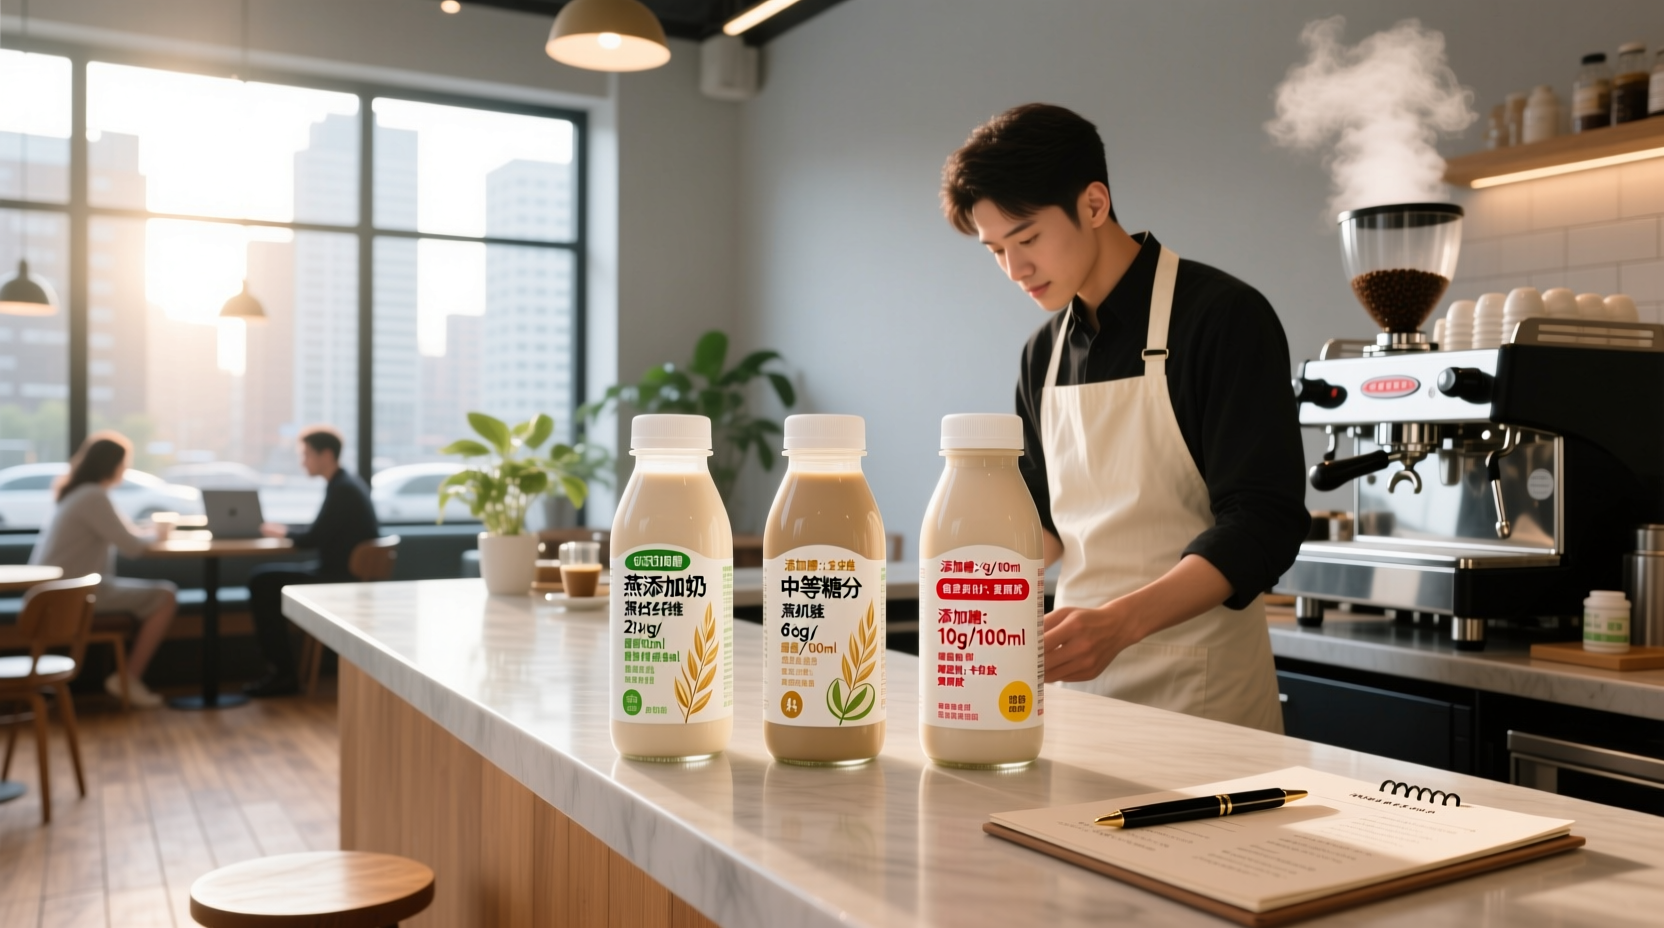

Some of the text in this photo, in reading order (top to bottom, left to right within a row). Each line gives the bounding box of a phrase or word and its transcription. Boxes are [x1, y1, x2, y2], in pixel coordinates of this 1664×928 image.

[624, 573, 707, 598] 燕添加奶
[781, 575, 862, 599] 中等糖分
[937, 626, 1026, 650] 10g/100ml
